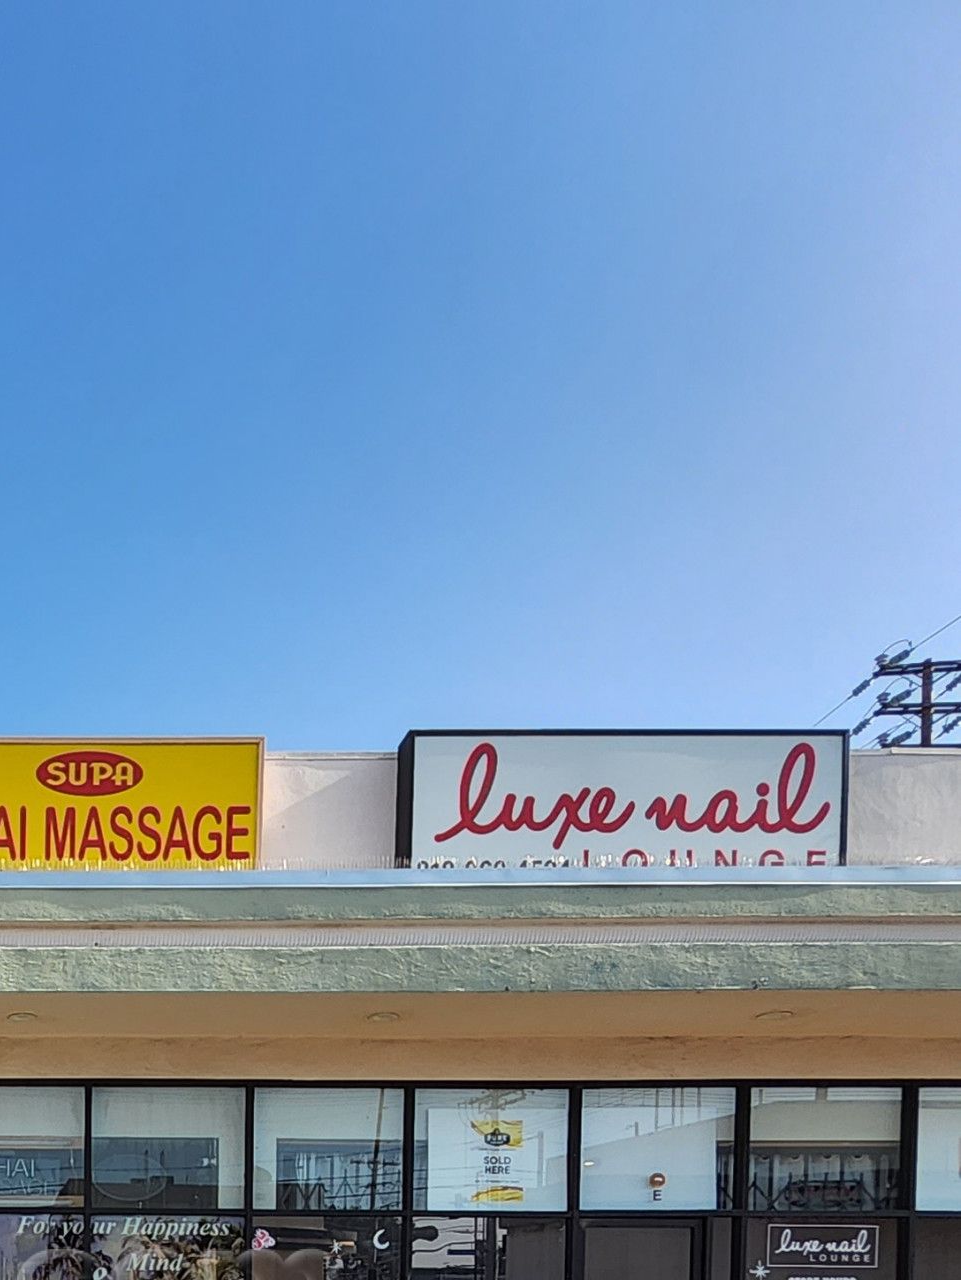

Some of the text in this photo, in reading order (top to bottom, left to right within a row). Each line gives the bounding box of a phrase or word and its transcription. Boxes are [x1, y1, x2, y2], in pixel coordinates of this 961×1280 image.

[46, 761, 134, 786] SUPA
[434, 742, 831, 849] luxe nail
[44, 805, 251, 862] MASSAGE
[483, 1156, 511, 1165] SOLD
[484, 1166, 511, 1175] HERE
[652, 1189, 662, 1201] E
[17, 1215, 58, 1234] For
[121, 1215, 230, 1241] Happiness
[774, 1229, 871, 1256] luxe nail
[809, 1254, 871, 1262] LOUNGE
